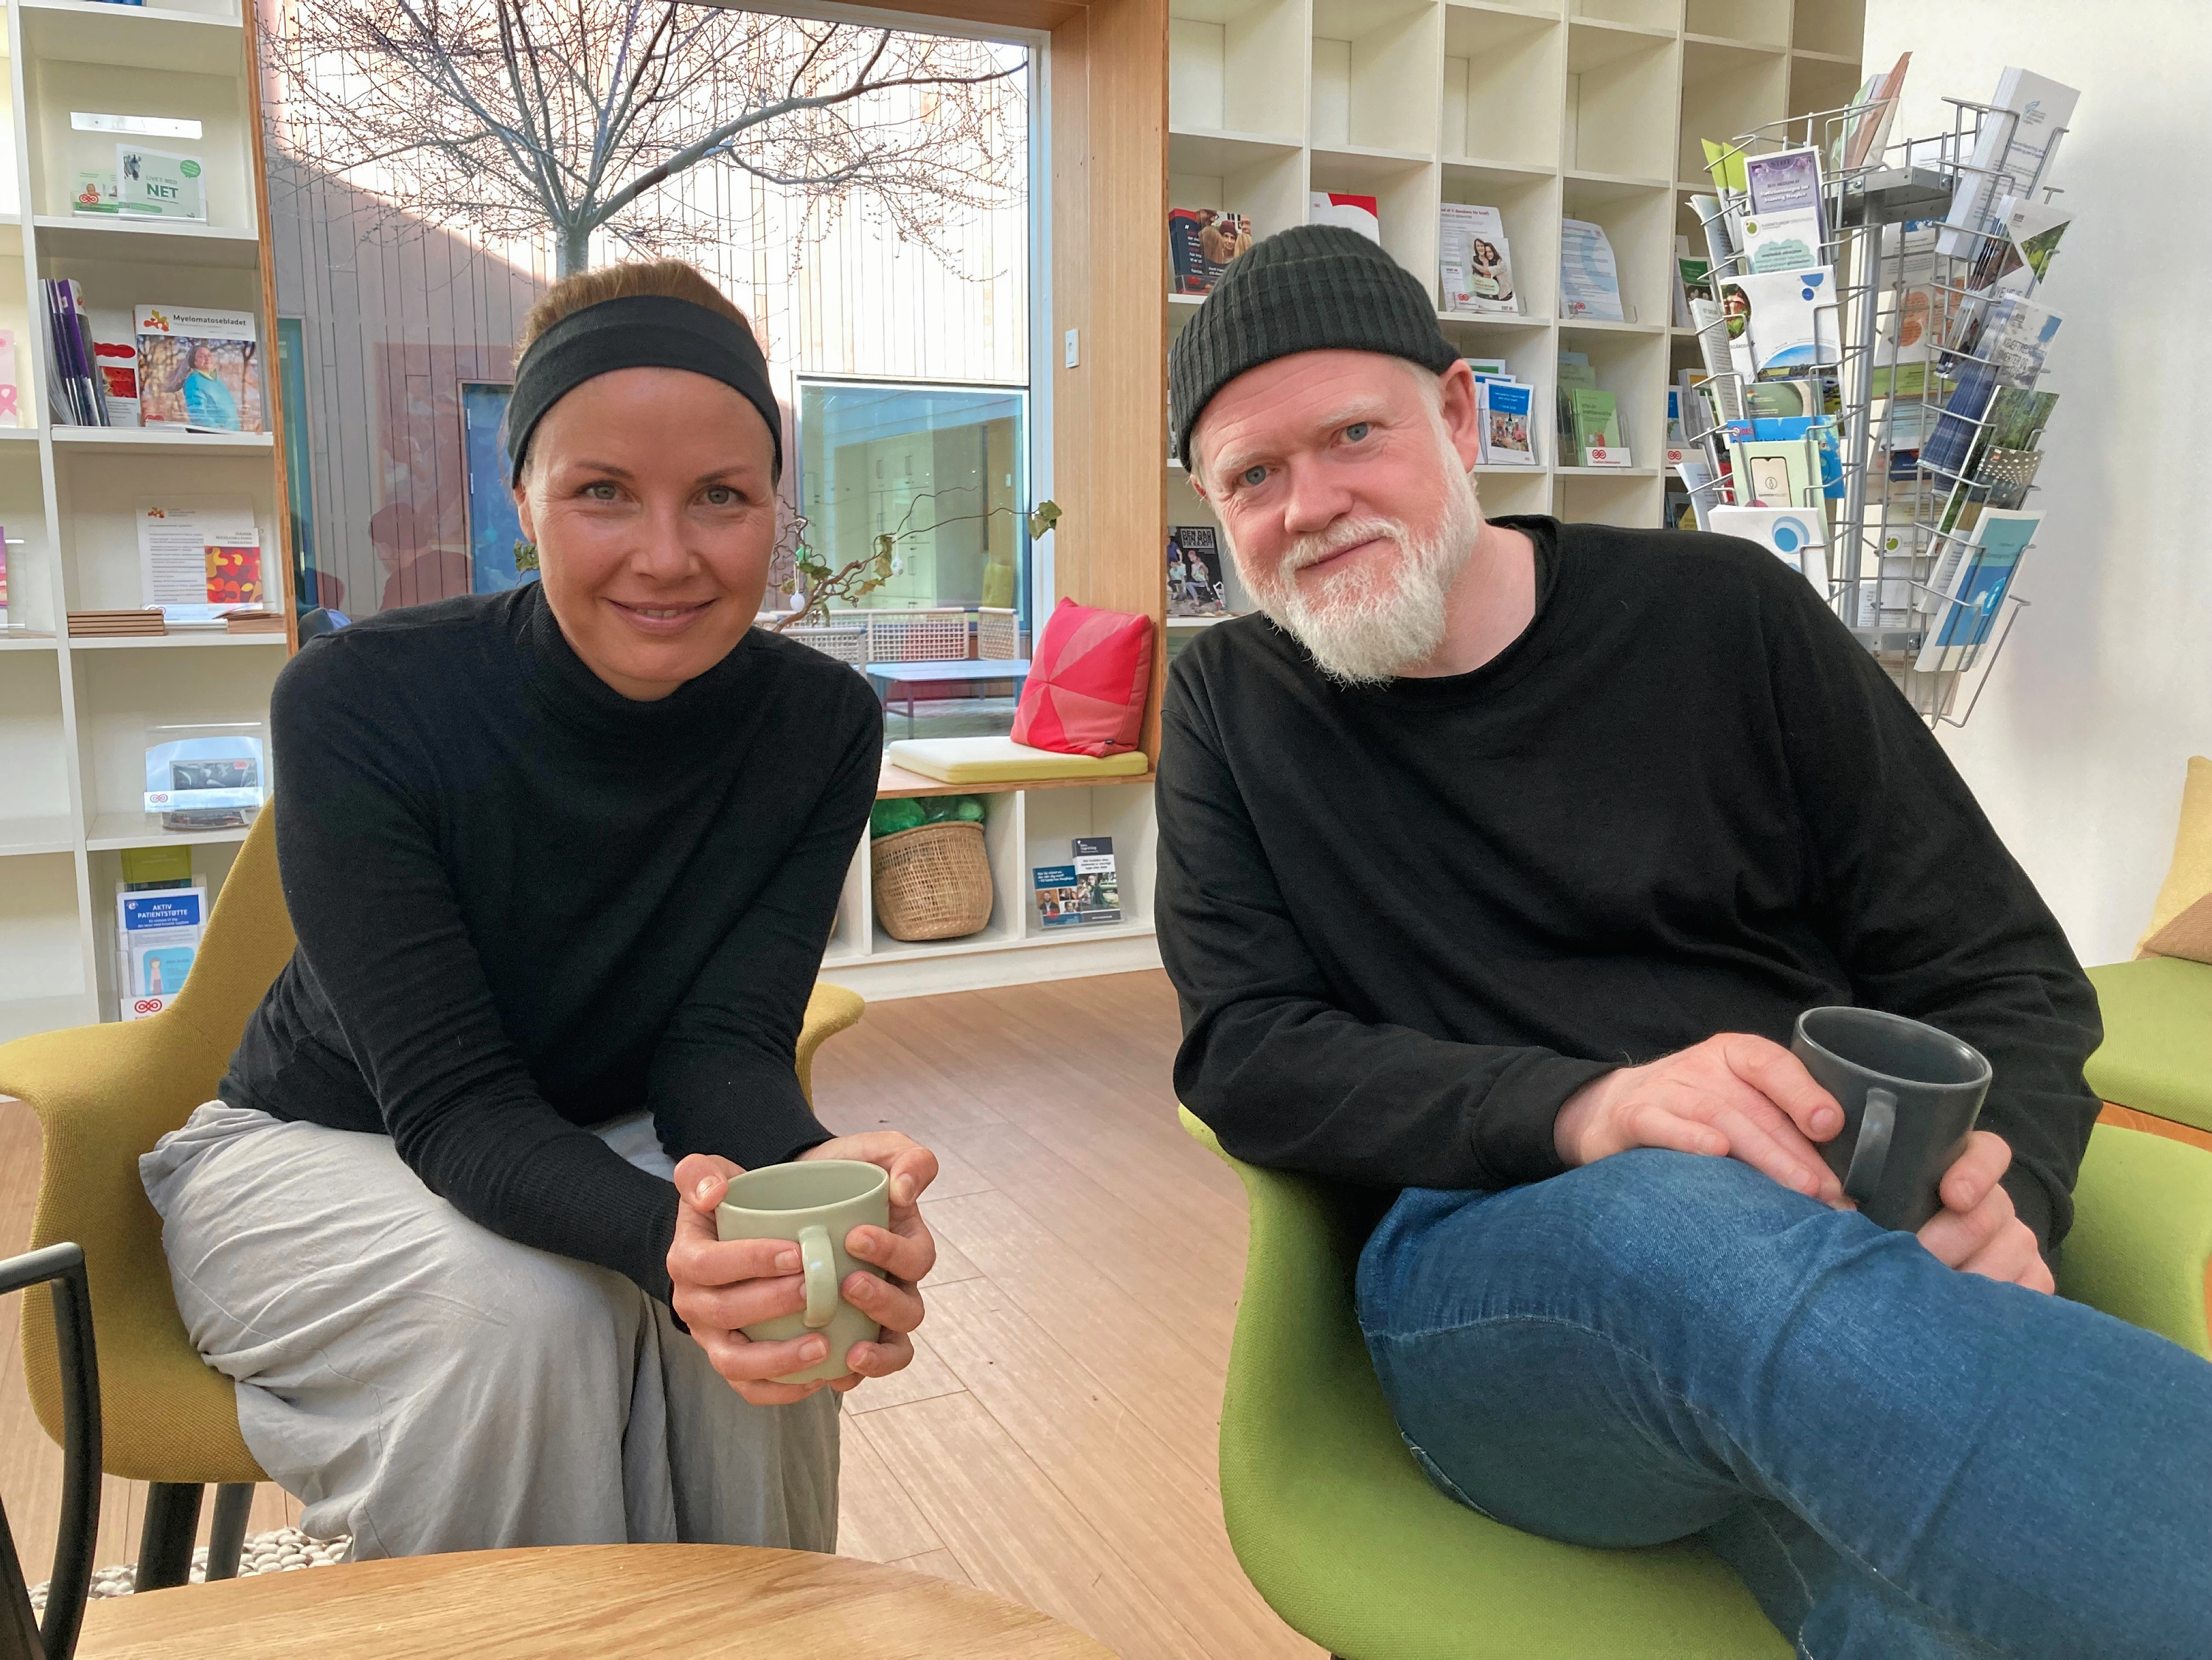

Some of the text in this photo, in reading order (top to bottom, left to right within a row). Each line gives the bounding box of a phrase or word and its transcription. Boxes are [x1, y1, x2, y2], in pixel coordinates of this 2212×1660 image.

[146, 175, 162, 183] LIVET
[146, 183, 179, 199] NET
[173, 314, 247, 326] Myelomatosebladet
[153, 903, 173, 911] AKTIV
[137, 909, 188, 919] PATIENTSTØTTE
